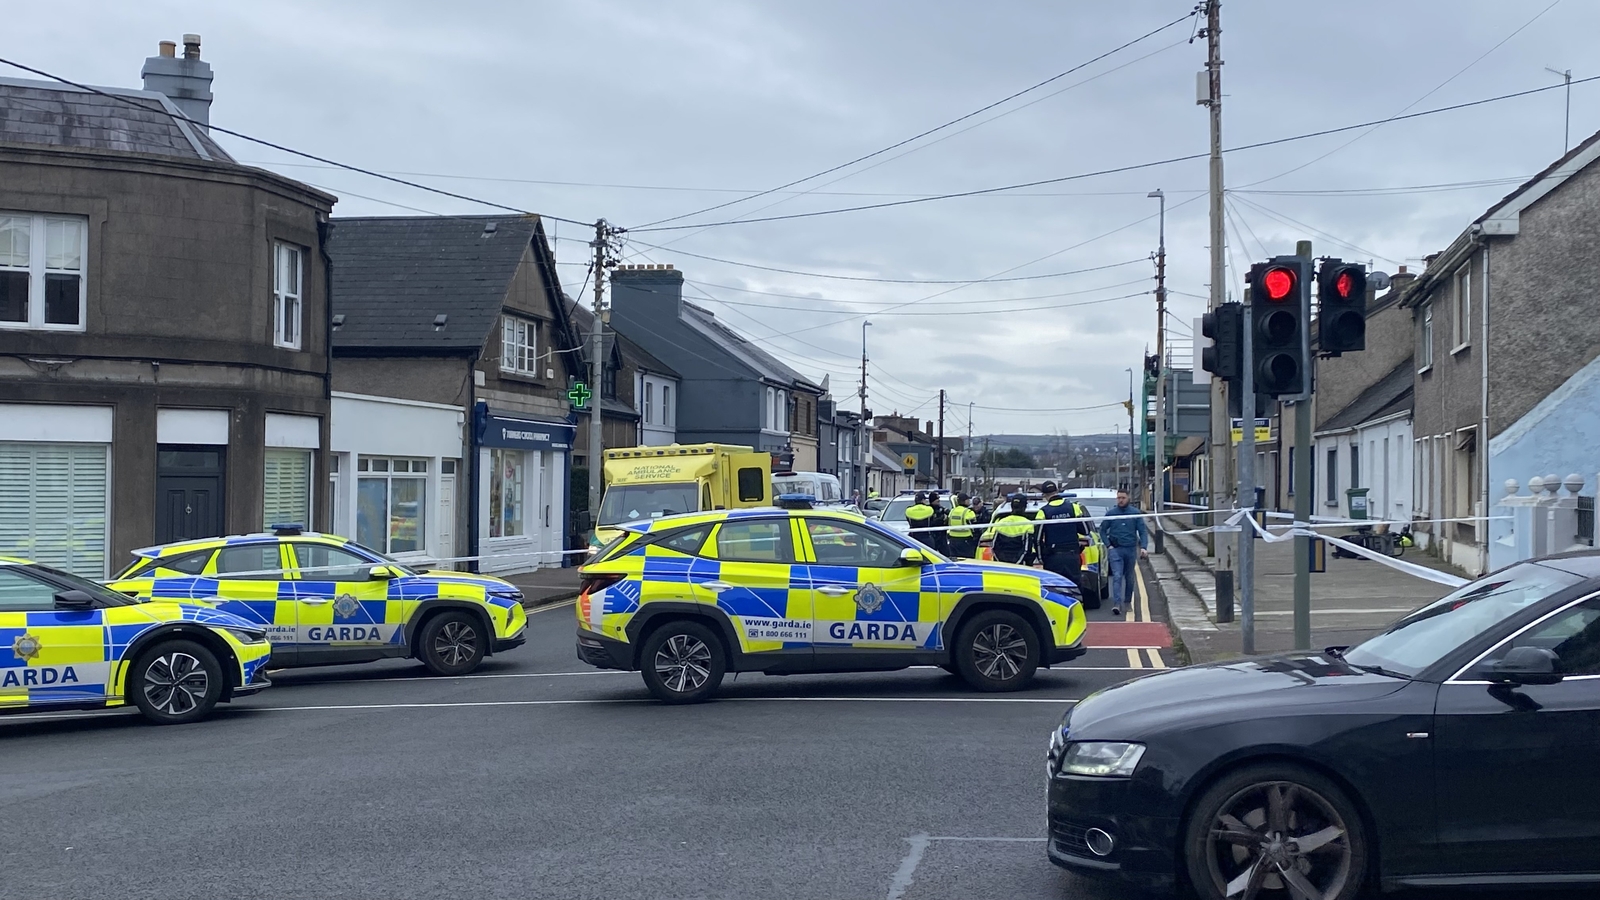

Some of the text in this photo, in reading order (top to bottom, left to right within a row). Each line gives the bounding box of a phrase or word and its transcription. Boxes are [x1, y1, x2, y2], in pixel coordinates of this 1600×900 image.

[745, 619, 812, 629] www.garda.ie
[308, 627, 382, 641] GARDA
[829, 622, 917, 642] GARDA
